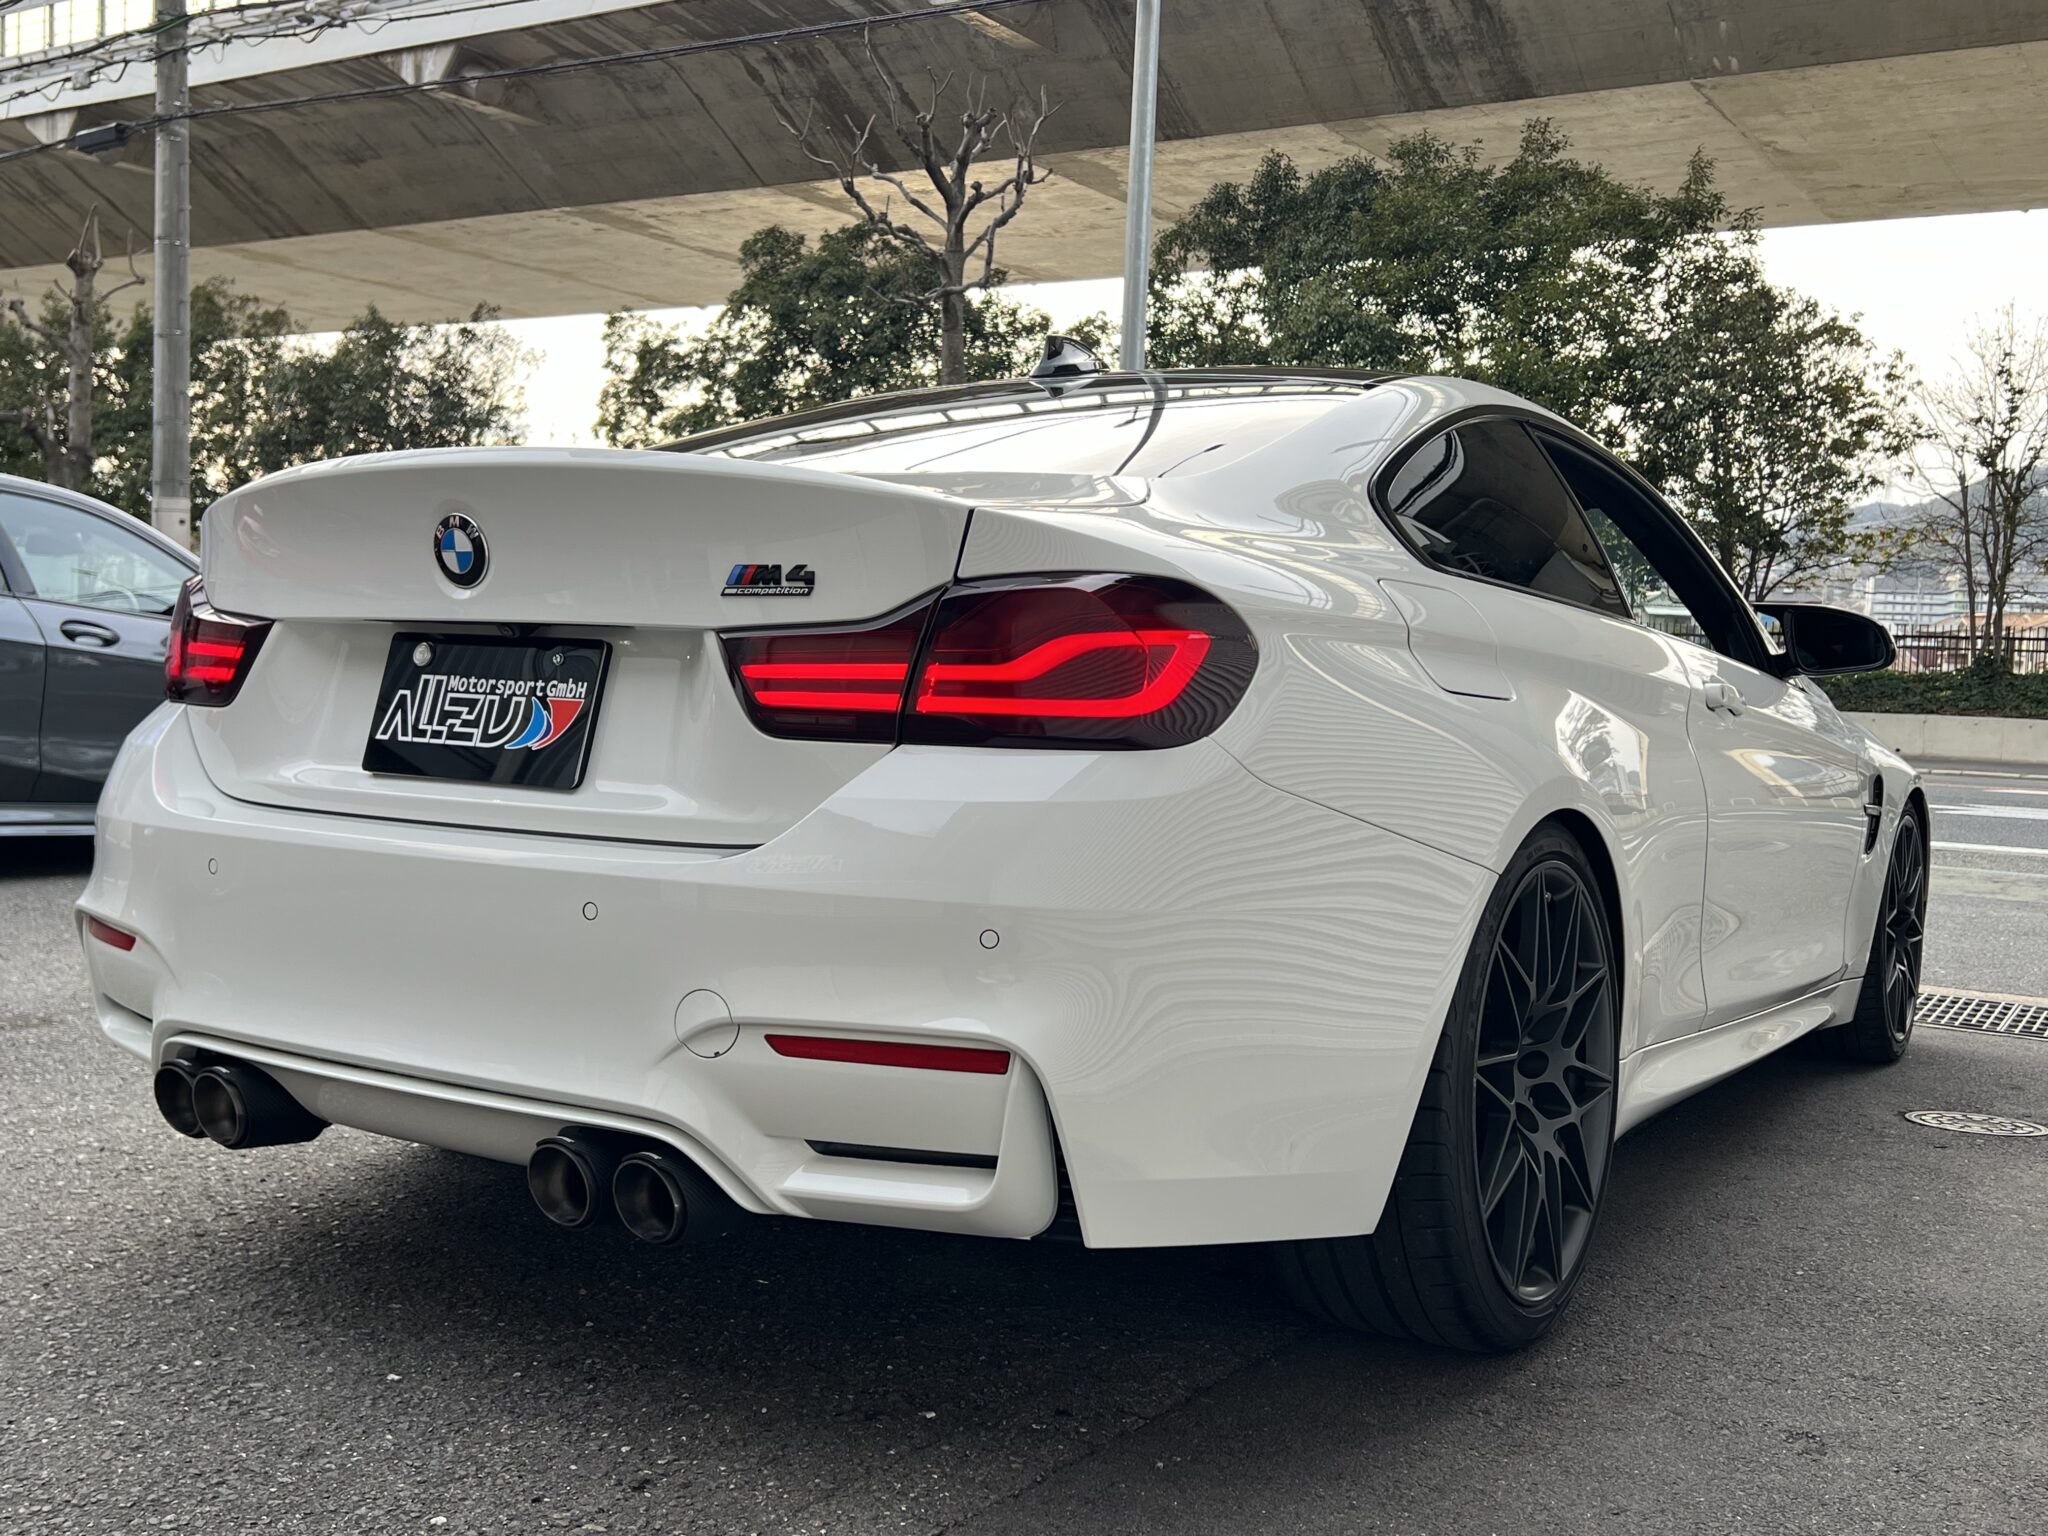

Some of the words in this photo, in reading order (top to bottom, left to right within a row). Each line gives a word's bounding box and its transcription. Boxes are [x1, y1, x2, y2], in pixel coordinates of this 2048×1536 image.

[436, 515, 479, 539] BMW
[737, 587, 809, 595] competition
[447, 674, 545, 698] Motorsport
[546, 678, 587, 698] GmbH
